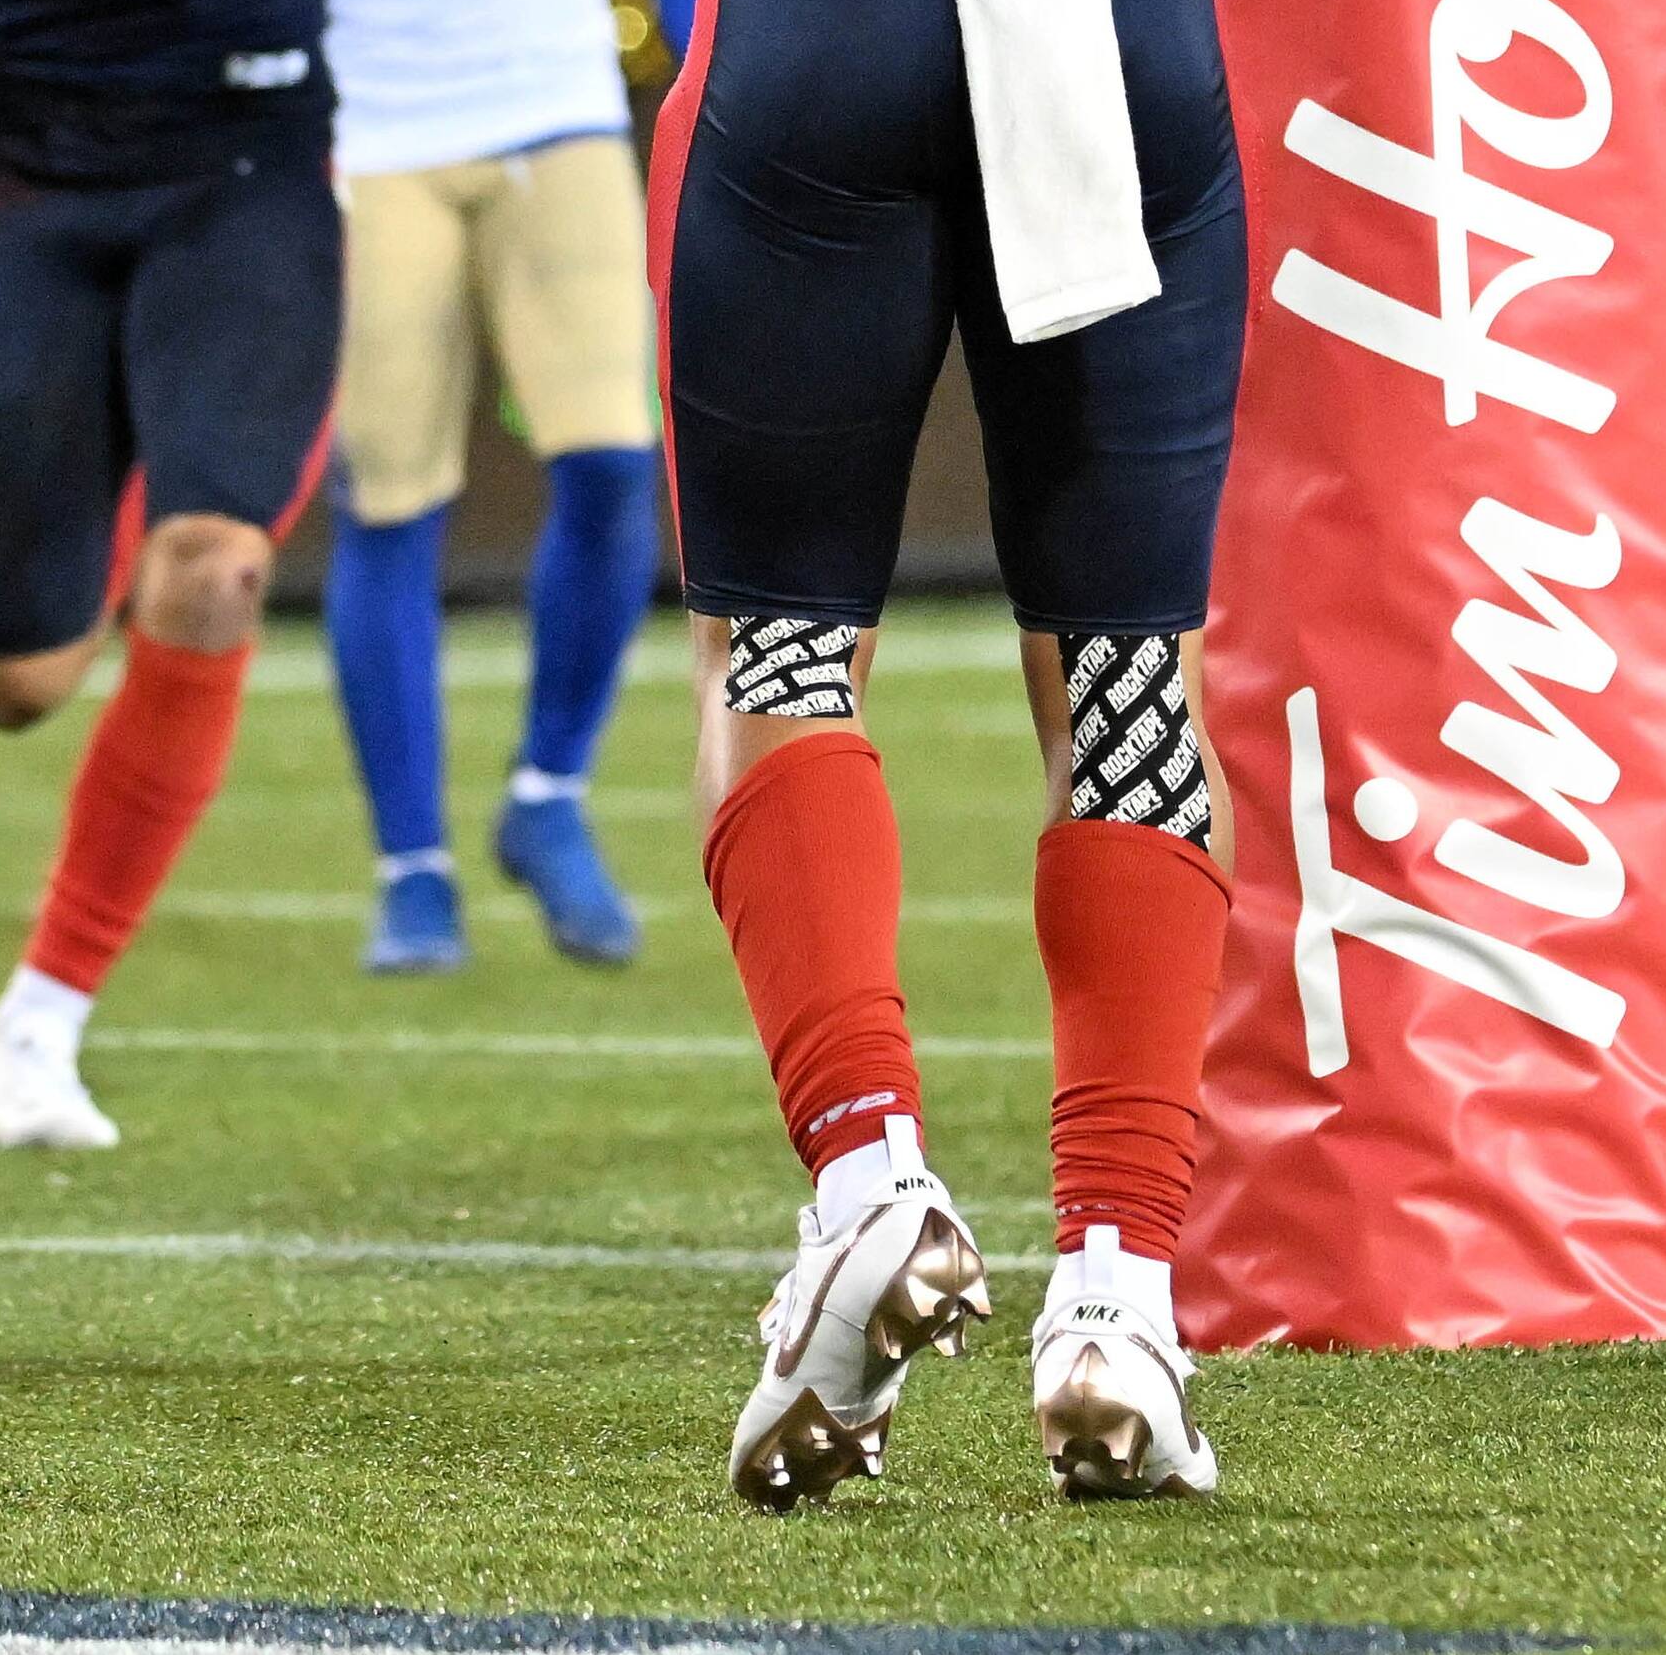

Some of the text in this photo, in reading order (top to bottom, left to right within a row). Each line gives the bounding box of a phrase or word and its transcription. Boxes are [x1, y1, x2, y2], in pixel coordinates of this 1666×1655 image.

[1067, 636, 1117, 709] OCKTAPE
[1105, 636, 1167, 712] ROCKTAPE
[1098, 706, 1167, 784] ROCKTAPE
[1287, 496, 1627, 1080] Tim
[1072, 1305, 1124, 1323] NIKE
